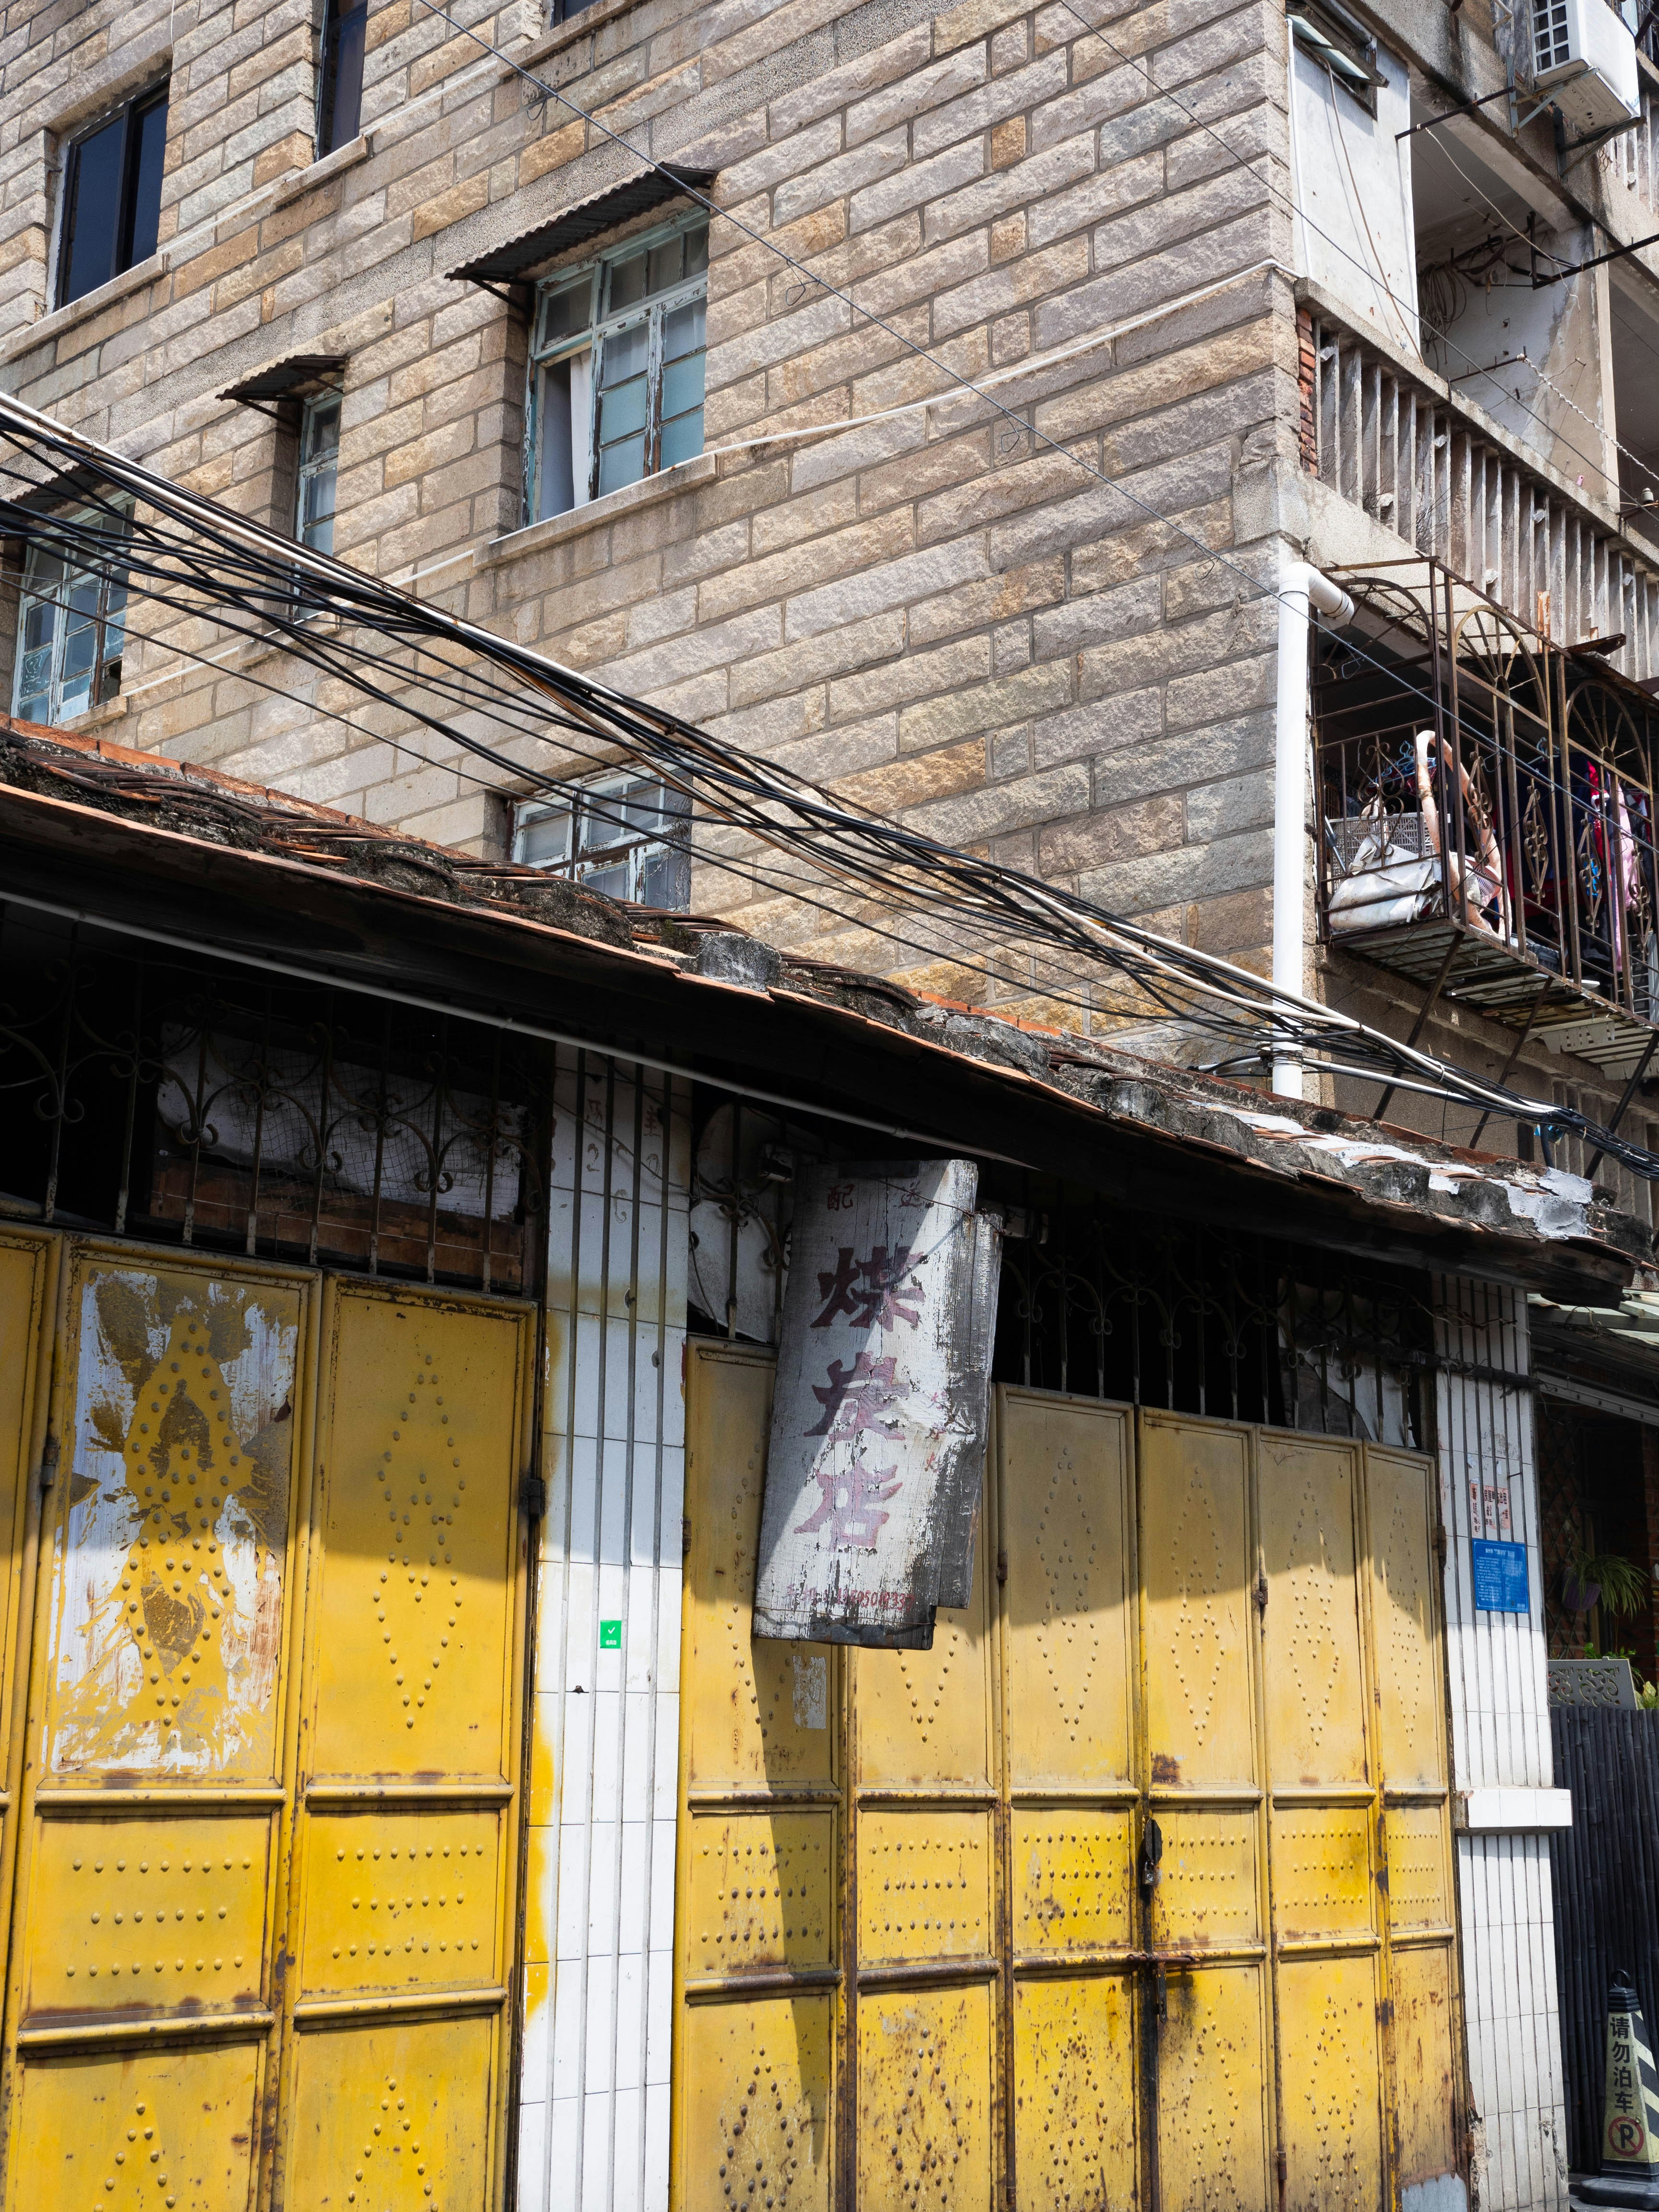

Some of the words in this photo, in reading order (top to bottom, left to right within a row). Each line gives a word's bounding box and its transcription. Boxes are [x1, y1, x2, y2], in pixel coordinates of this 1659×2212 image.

[794, 1246, 926, 1551] 煤炭店
[1610, 2017, 1634, 2113] 请勿泊车
